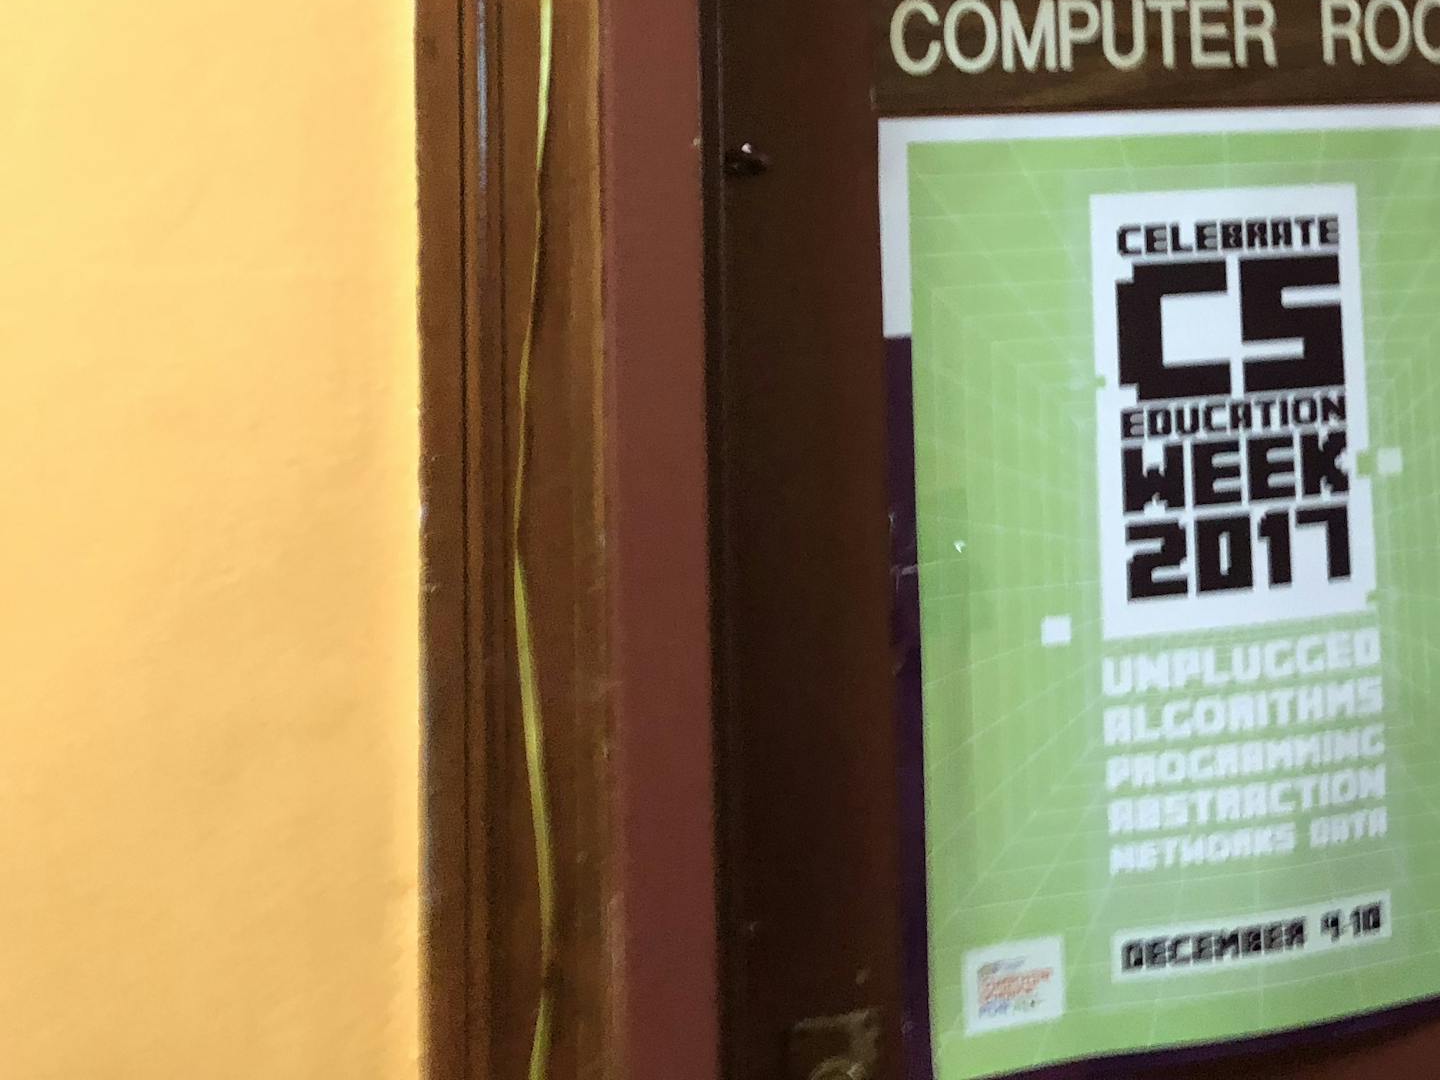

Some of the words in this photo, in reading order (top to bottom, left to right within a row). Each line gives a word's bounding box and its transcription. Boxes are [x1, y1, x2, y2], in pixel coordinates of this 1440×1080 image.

[1116, 216, 1340, 256] CELEBRATE
[1115, 254, 1347, 401] CS
[1120, 394, 1347, 440] EDUCATION
[1121, 429, 1350, 515] WEEK
[1124, 506, 1351, 603] 2017
[1102, 627, 1382, 697] UNPLUGGED
[1103, 676, 1384, 747] ALGORITHMS
[1105, 723, 1386, 791] PROGRAMMING
[1108, 763, 1387, 836] ABSTRACTION
[1109, 821, 1297, 875] NETWORKS
[1121, 916, 1308, 973] DECEMBER
